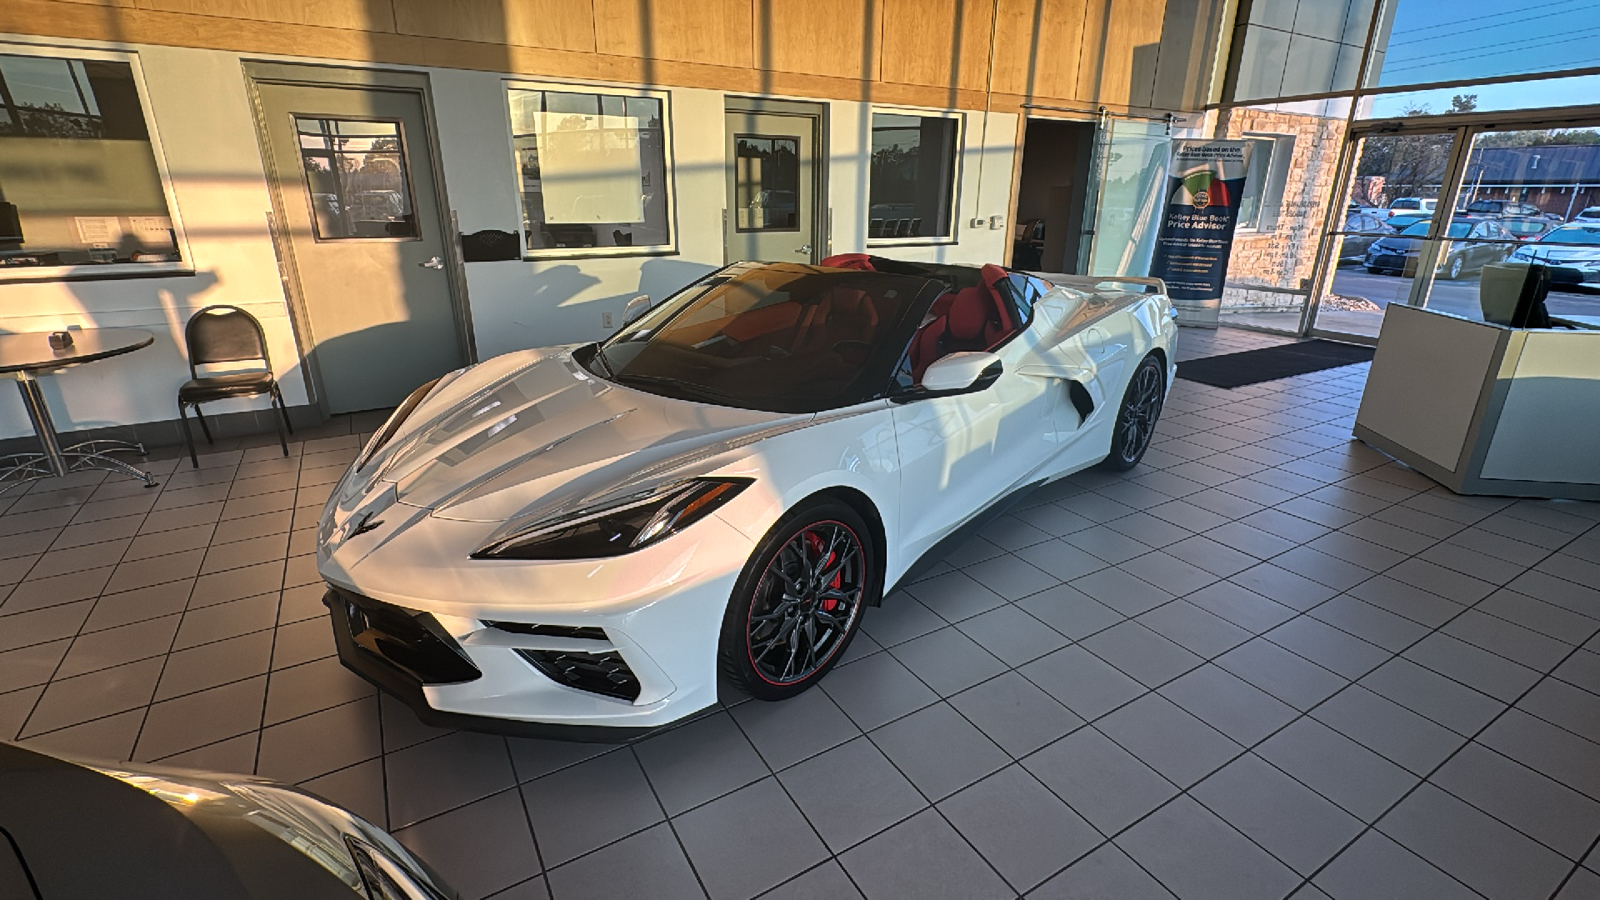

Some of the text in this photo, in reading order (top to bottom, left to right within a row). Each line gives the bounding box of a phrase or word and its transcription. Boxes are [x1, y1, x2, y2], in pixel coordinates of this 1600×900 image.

[1169, 213, 1190, 221] Kelley
[1168, 221, 1226, 230] Price Advisor
